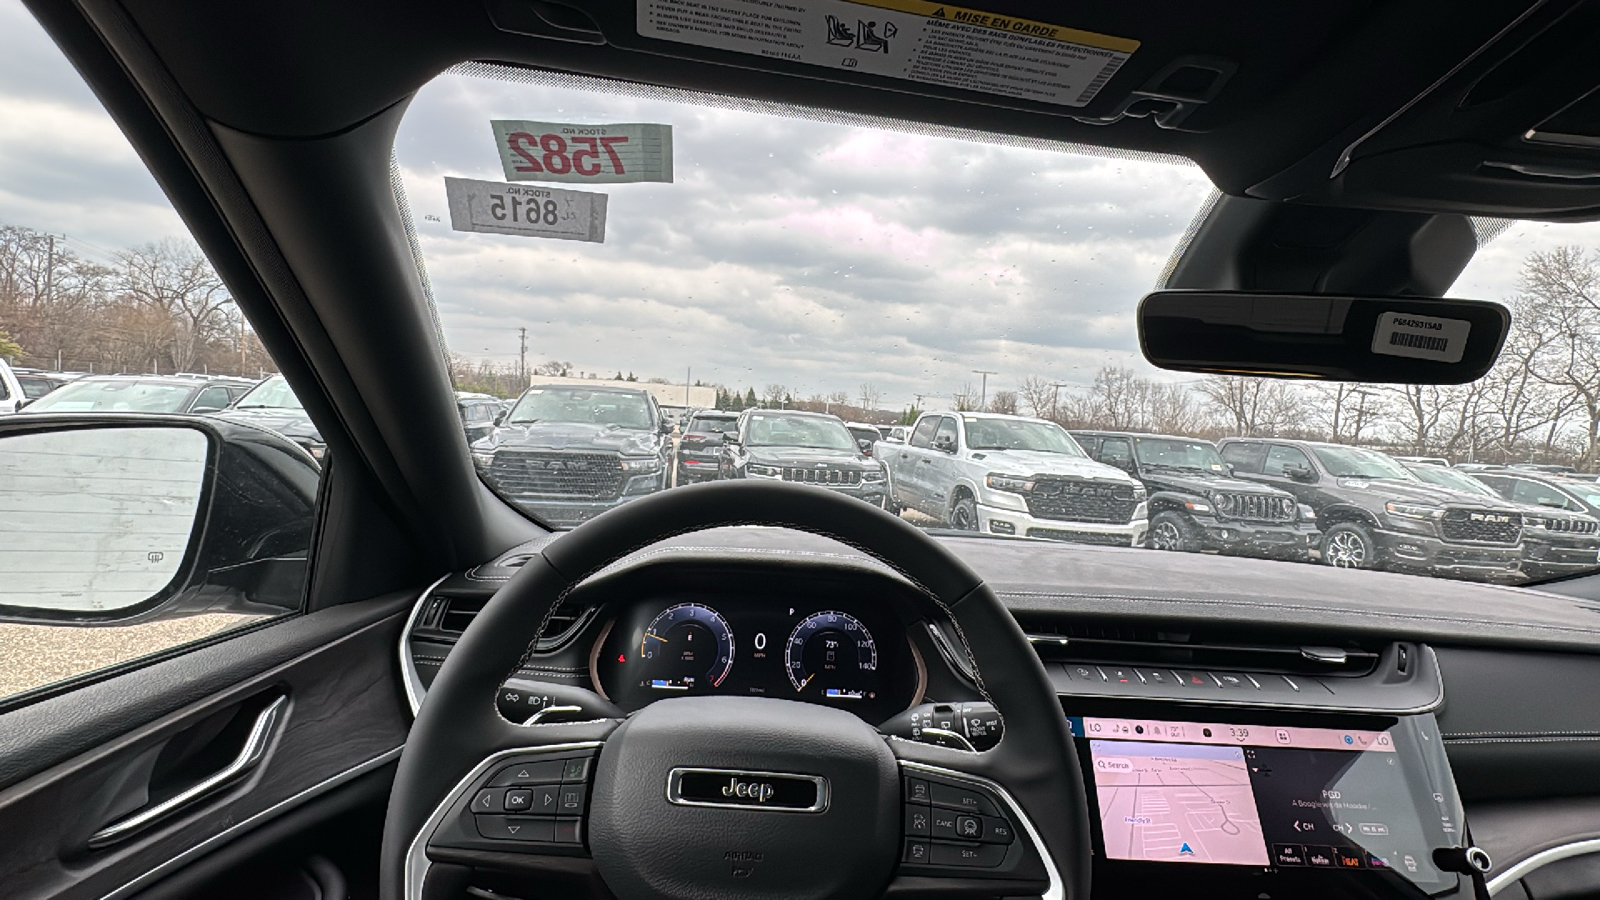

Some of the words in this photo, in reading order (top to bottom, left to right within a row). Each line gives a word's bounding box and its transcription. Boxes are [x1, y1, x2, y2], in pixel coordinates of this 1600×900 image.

[955, 11, 990, 26] MISE
[990, 18, 1010, 29] EN
[1012, 22, 1058, 37] GARDE
[926, 18, 950, 28] MÊME
[950, 23, 971, 32] AVEC
[971, 27, 987, 35] DES
[1008, 34, 1055, 47] GONFLABLES
[1471, 513, 1509, 523] RAM
[710, 615, 716, 623] 4
[754, 632, 766, 650] 0
[858, 640, 869, 648] 120
[792, 661, 801, 669] 20
[1090, 723, 1101, 732] LO
[1229, 728, 1249, 737] 3:39
[1377, 735, 1389, 745] LO
[1107, 760, 1129, 769] Search
[722, 778, 774, 802] Jeep
[1322, 790, 1341, 799] PGD
[511, 796, 525, 804] OK
[936, 820, 952, 828] CANC
[1302, 823, 1315, 831] CH
[995, 828, 1007, 836] RES
